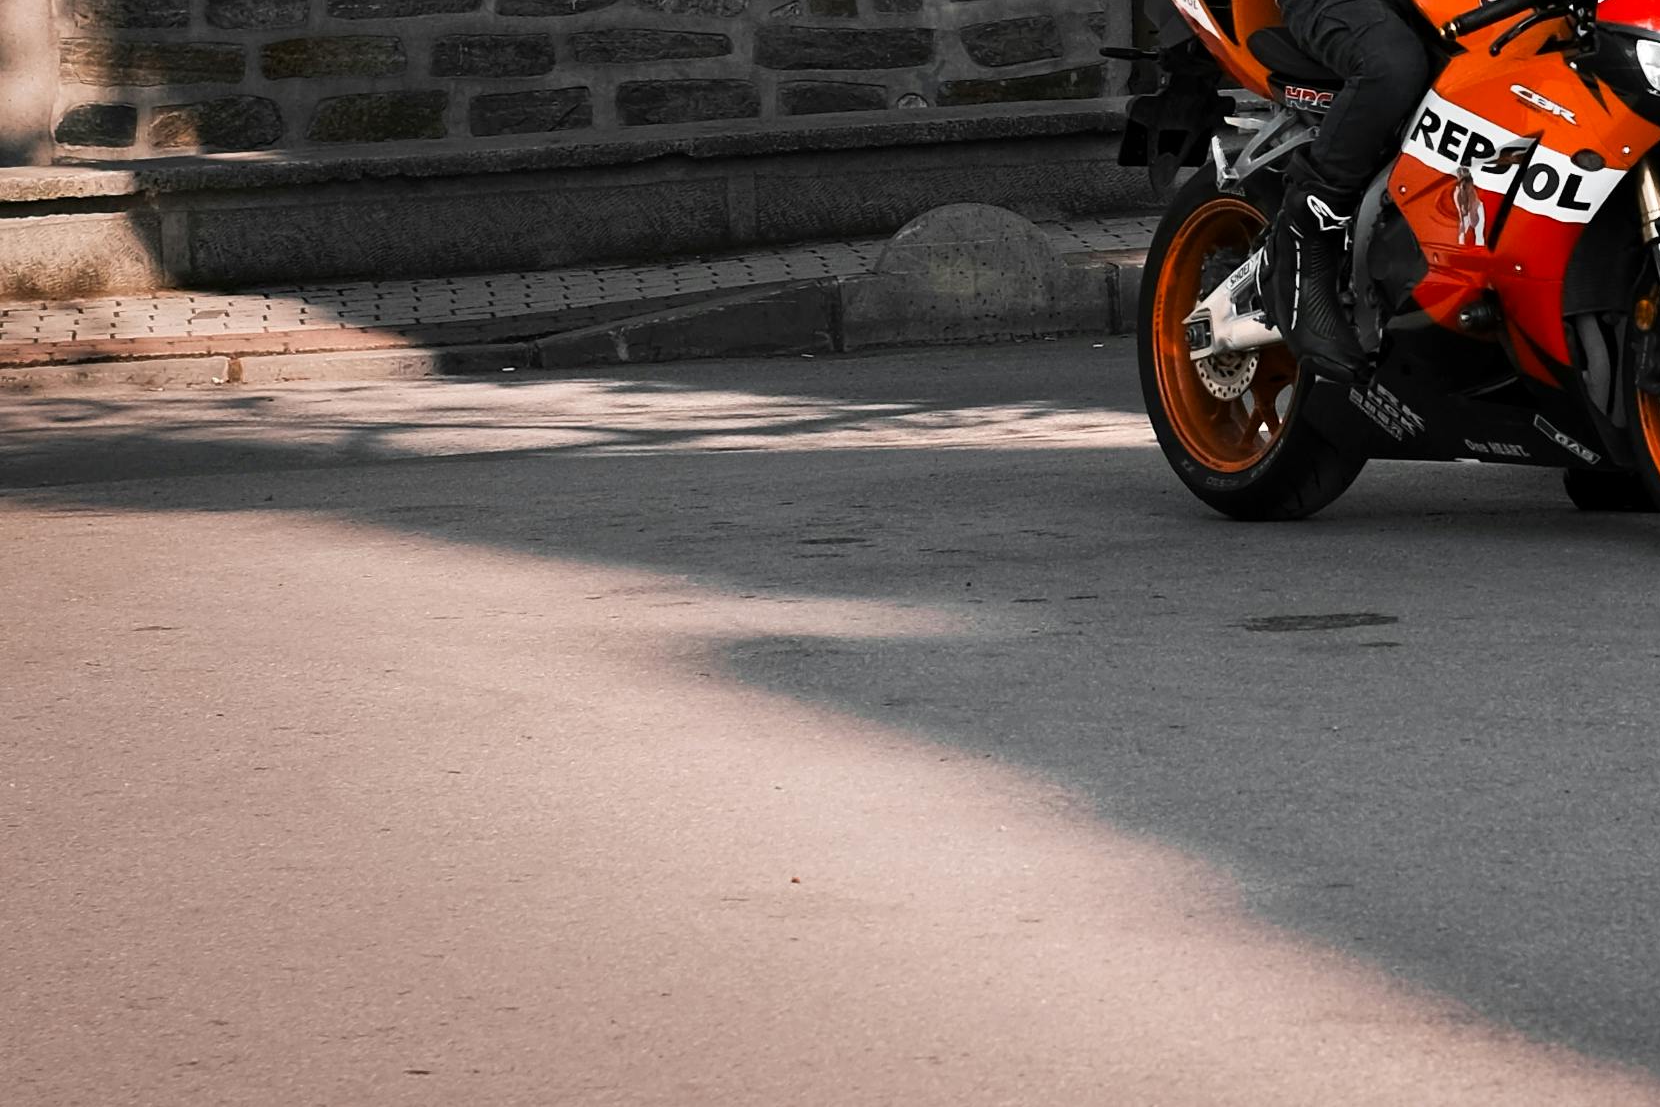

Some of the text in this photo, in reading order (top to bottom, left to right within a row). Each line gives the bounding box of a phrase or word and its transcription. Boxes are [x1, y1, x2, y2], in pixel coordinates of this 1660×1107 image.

[1285, 86, 1334, 110] HRC
[1510, 84, 1577, 125] CBR
[1410, 107, 1592, 211] REPSOL
